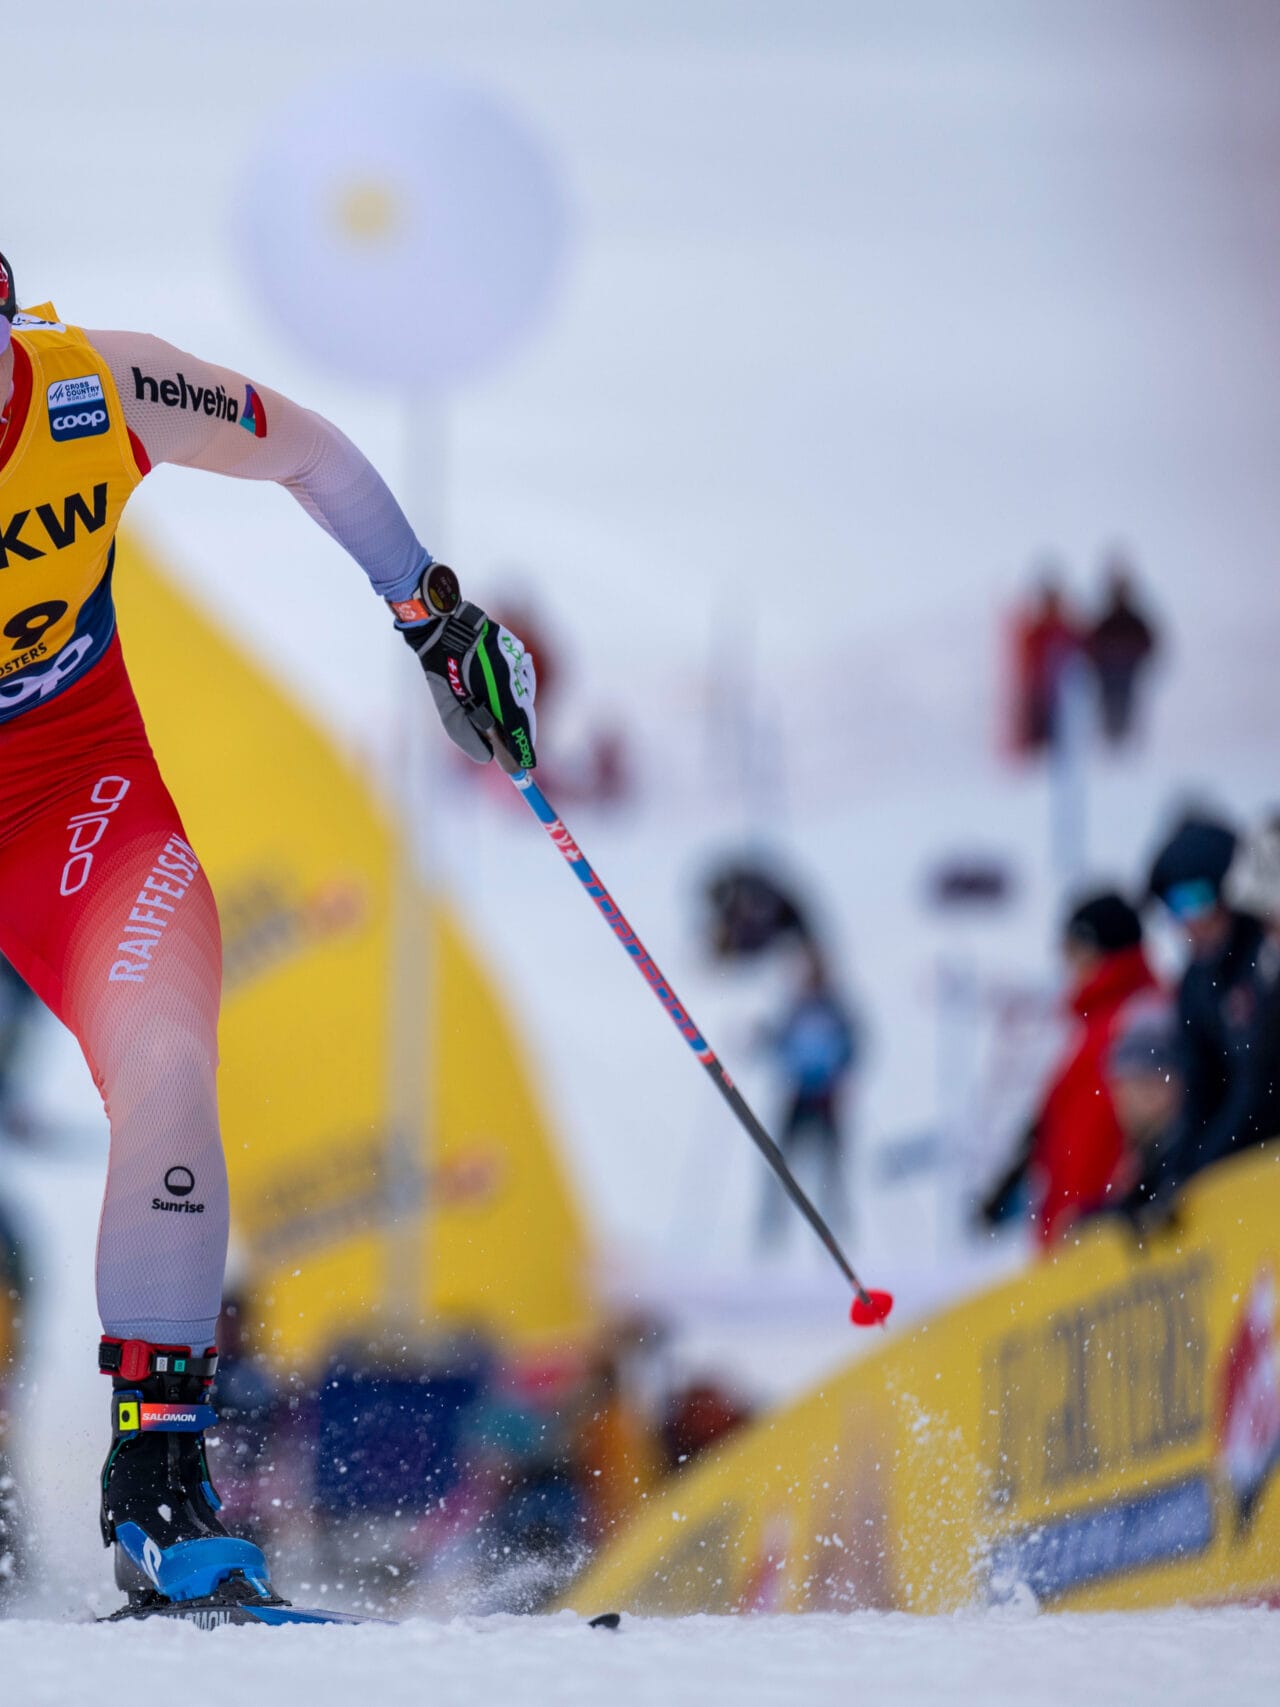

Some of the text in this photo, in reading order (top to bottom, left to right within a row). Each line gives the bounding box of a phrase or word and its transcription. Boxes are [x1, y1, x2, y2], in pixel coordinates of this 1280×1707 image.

[65, 381, 89, 391] CROSS
[66, 385, 99, 397] COUNTRY
[131, 366, 238, 423] helvetia
[53, 410, 106, 430] coop
[108, 832, 200, 983] RAIFFEISEN
[152, 1198, 205, 1213] Sunrise
[142, 1412, 196, 1422] SALOMON
